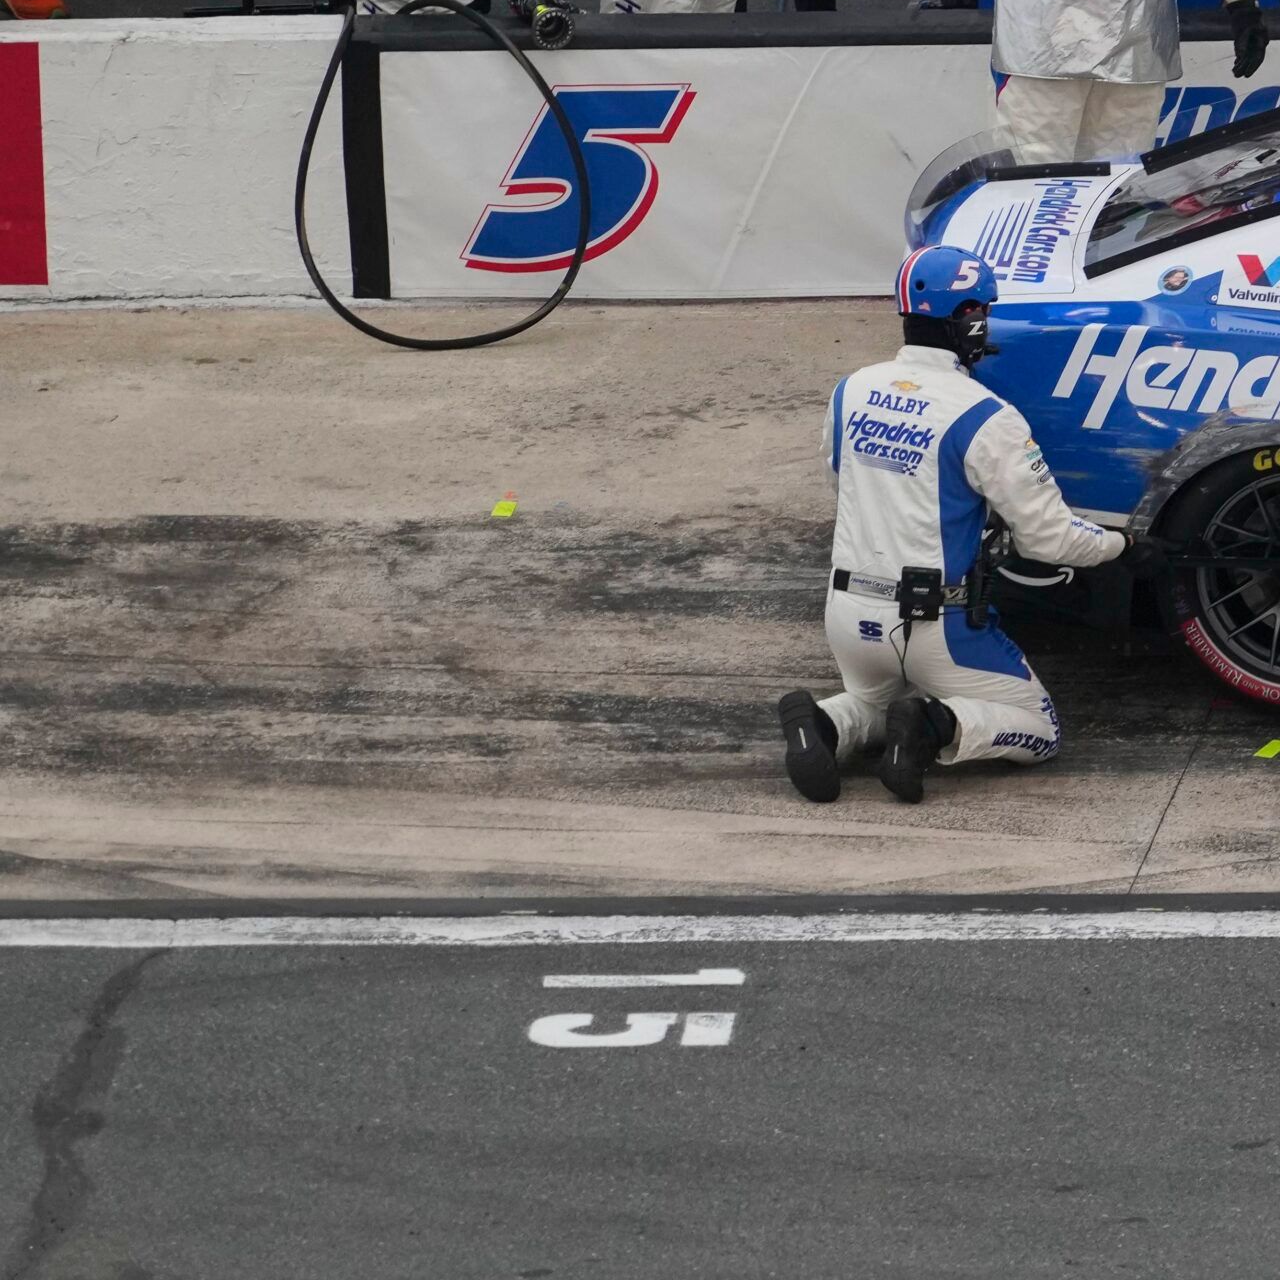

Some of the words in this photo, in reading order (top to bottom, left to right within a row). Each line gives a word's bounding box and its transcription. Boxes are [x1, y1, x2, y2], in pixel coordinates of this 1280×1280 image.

[459, 83, 697, 273] 5
[1011, 177, 1093, 285] HendrickCars.com
[950, 259, 981, 291] 5
[865, 390, 930, 416] DALBY
[846, 411, 935, 450] Hendrick
[853, 435, 924, 465] Cars.com
[1186, 622, 1243, 688] REMEMBER
